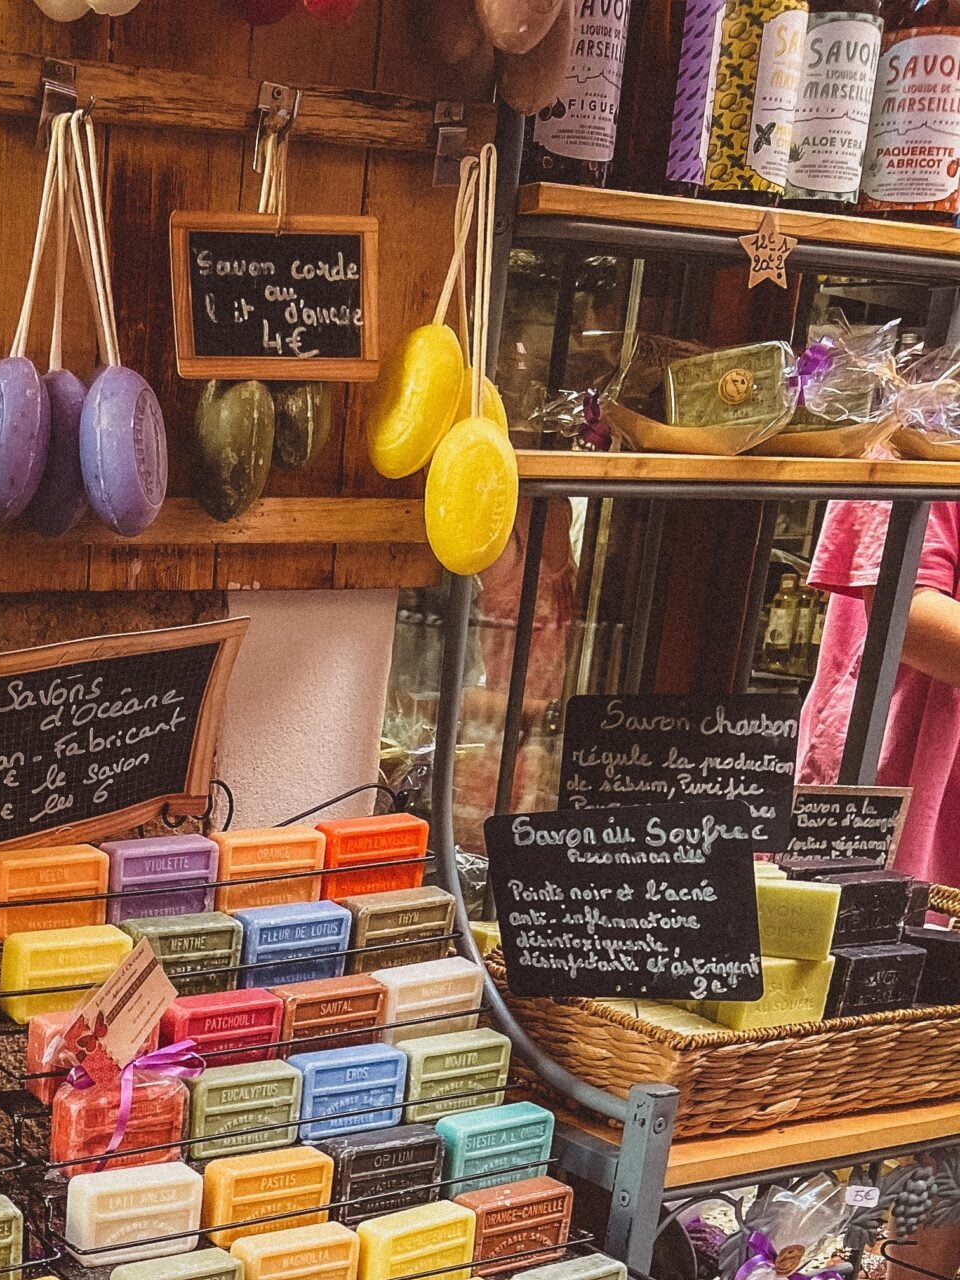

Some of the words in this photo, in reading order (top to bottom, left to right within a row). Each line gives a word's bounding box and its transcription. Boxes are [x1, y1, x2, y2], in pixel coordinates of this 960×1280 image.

[580, 24, 613, 38] LIQUIDE
[808, 37, 878, 72] SAVON
[825, 69, 858, 80] LIQUIDE
[902, 83, 937, 94] LIQUIDE
[939, 84, 951, 94] DE
[568, 99, 614, 114] FIGUE
[801, 136, 836, 147] ALOE
[839, 137, 863, 149] VERA
[876, 147, 955, 158] PAQUERETTE
[886, 158, 943, 169] ABRICOT
[196, 249, 276, 276] Savon
[291, 252, 360, 282] corde
[265, 285, 298, 301] au
[262, 319, 320, 359] 4€
[40, 687, 185, 731] d'Océane
[600, 700, 690, 732] Savon
[572, 744, 653, 778] régule
[661, 747, 695, 770] la
[699, 752, 795, 777] production
[32, 766, 67, 794] le
[566, 774, 592, 792] de
[30, 793, 74, 822] les
[93, 779, 113, 804] 6
[793, 796, 841, 814] Savon
[862, 797, 878, 814] la
[511, 816, 597, 847] Savon
[144, 856, 191, 873] VIOLETTE
[507, 879, 565, 902] Points
[570, 884, 613, 901] noir
[616, 883, 635, 901] et
[645, 878, 718, 902] l'acné
[261, 927, 292, 942] FLEUR
[295, 925, 308, 937] DE
[310, 922, 338, 936] LOTUS
[170, 936, 206, 951] MENTHE
[319, 999, 354, 1015] SANTAL
[204, 1012, 257, 1030] PATCHOULI
[444, 1052, 479, 1068] MOJITO
[345, 1066, 369, 1082] EROS
[221, 1083, 280, 1103] EUCALYPTUS
[465, 1135, 496, 1150] SIESTE
[499, 1132, 508, 1144] A
[374, 1150, 415, 1168] OPIUM
[260, 1174, 297, 1191] PASTIS
[853, 1188, 877, 1202] 5€
[484, 1198, 564, 1227] ORANGE-CANNELLE
